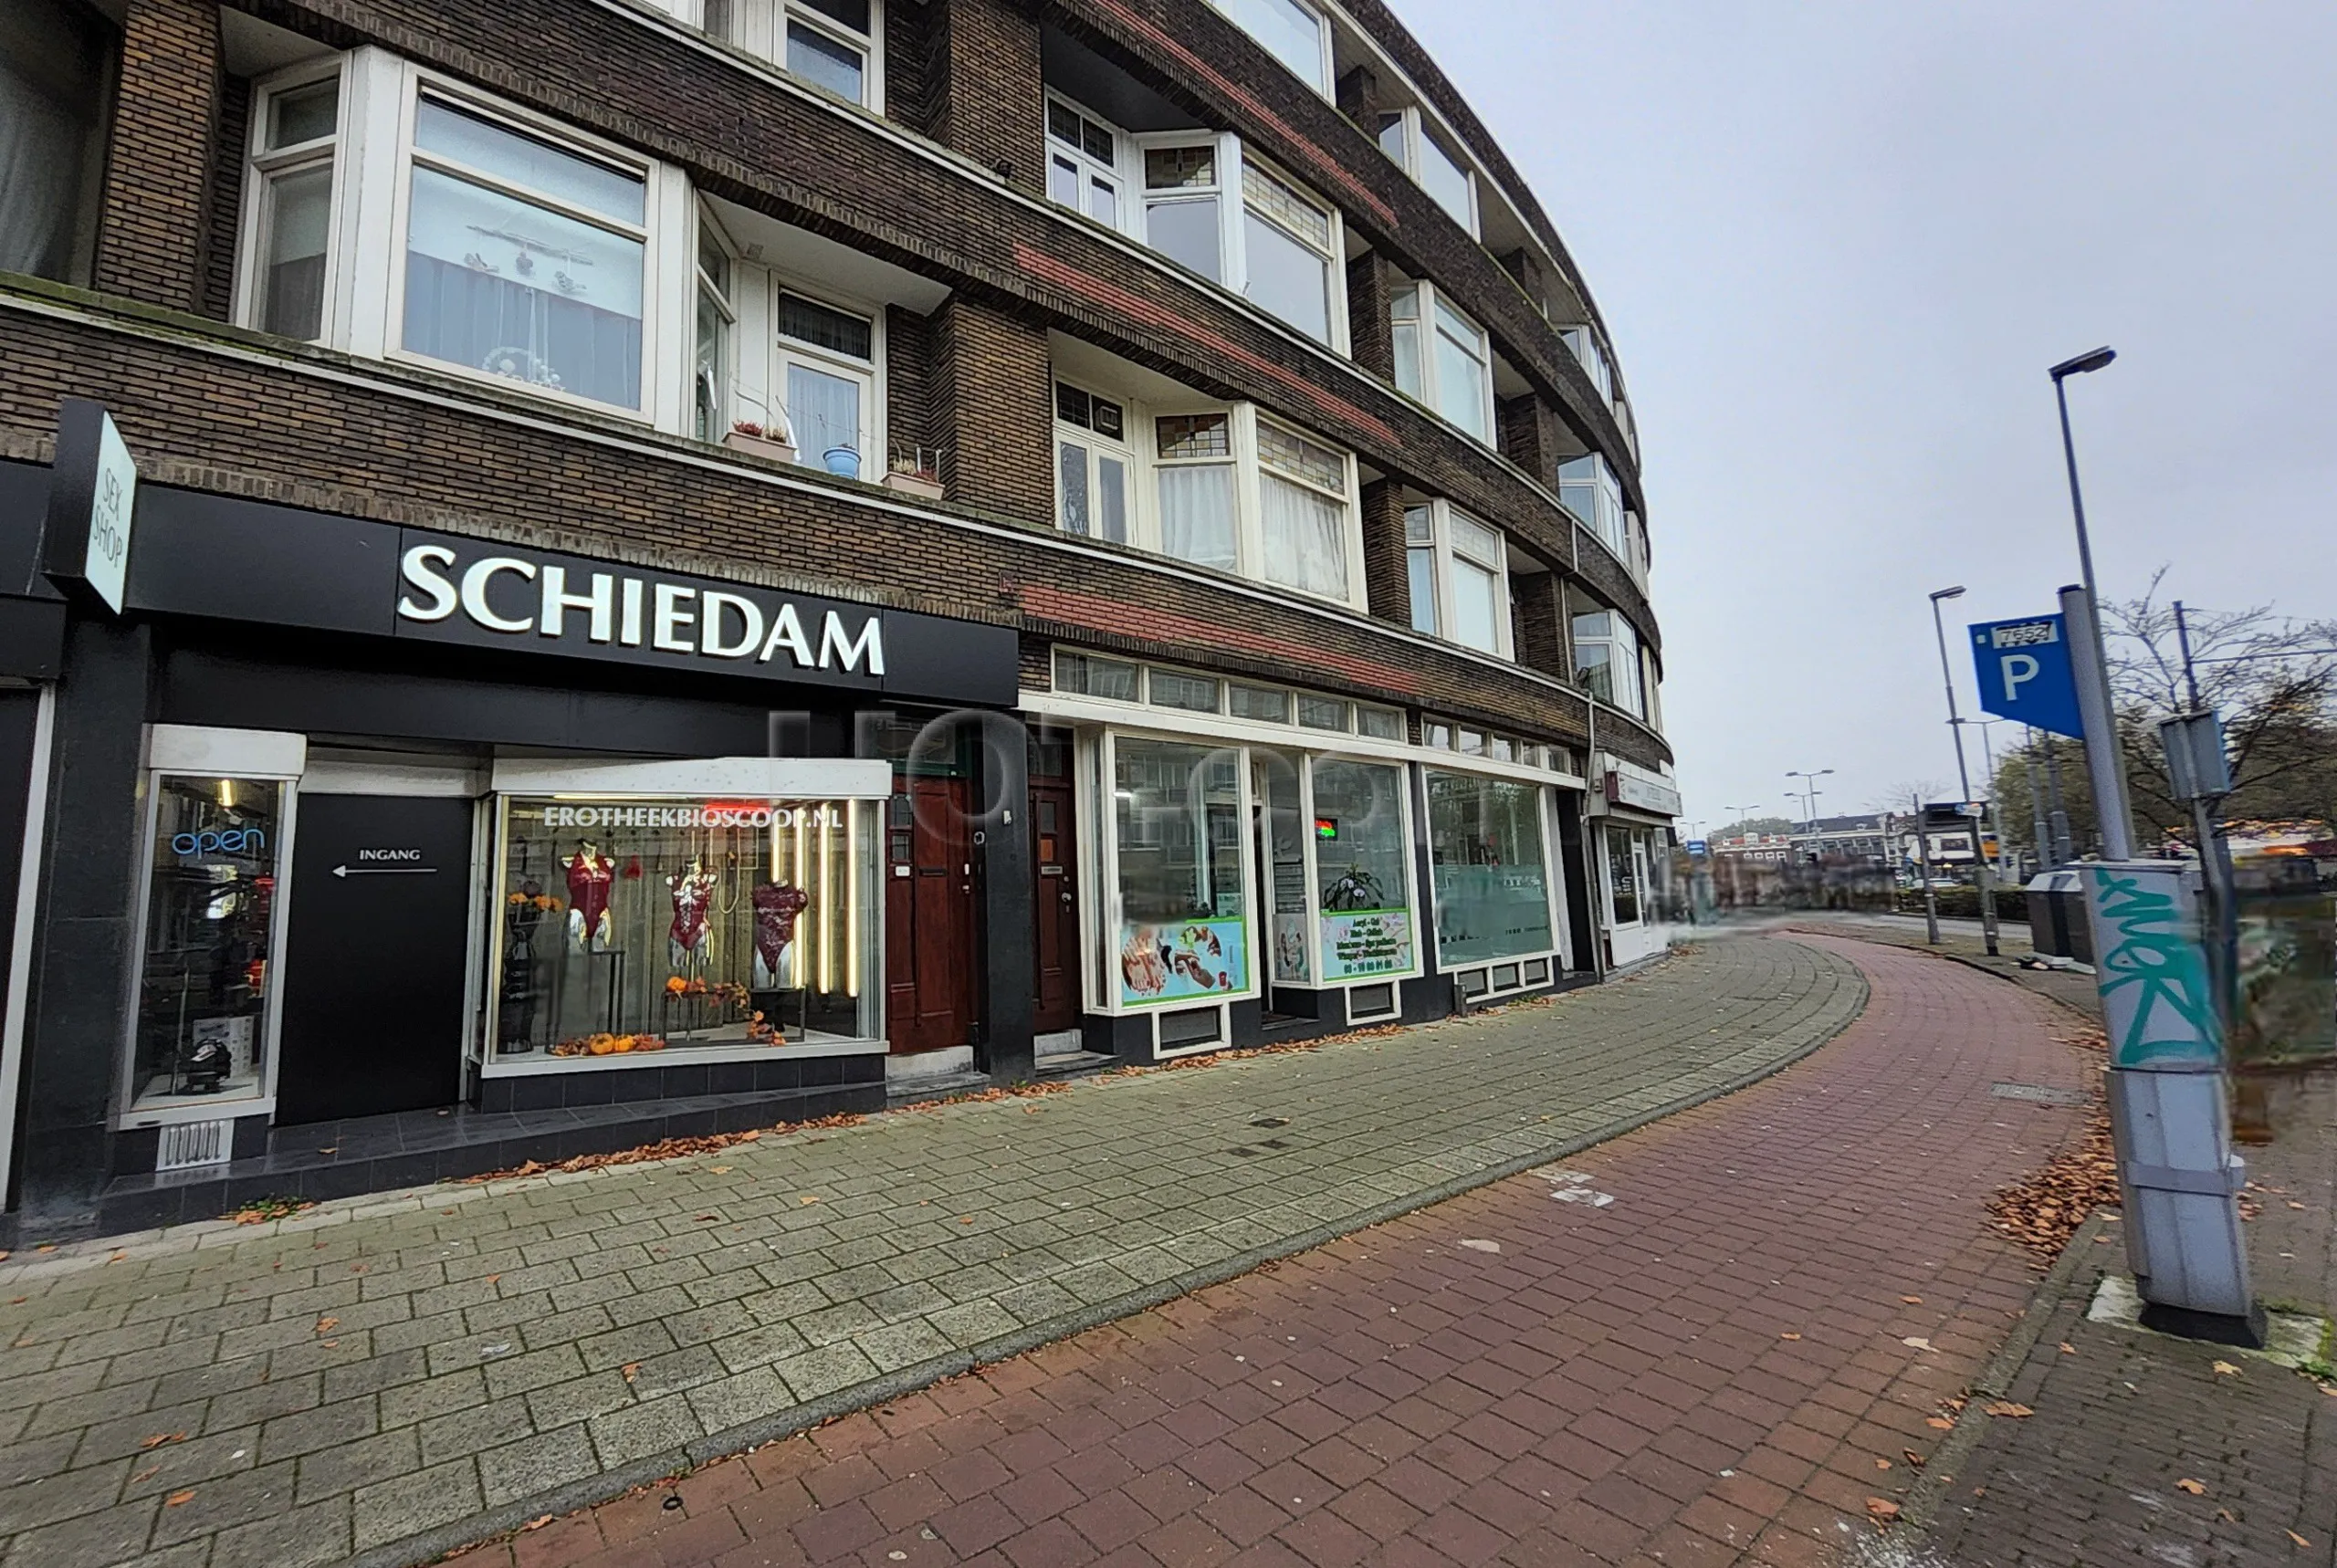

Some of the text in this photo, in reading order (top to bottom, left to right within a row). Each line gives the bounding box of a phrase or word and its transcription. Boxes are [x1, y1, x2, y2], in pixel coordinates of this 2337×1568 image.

[103, 467, 122, 521] SEX
[93, 504, 122, 569] SHOP
[396, 544, 886, 677] SCHIEDAM
[2000, 653, 2039, 701] P
[544, 806, 844, 829] EROTHEEKBIOSCOOP.NL
[171, 826, 266, 860] open
[359, 849, 421, 861] INGANG
